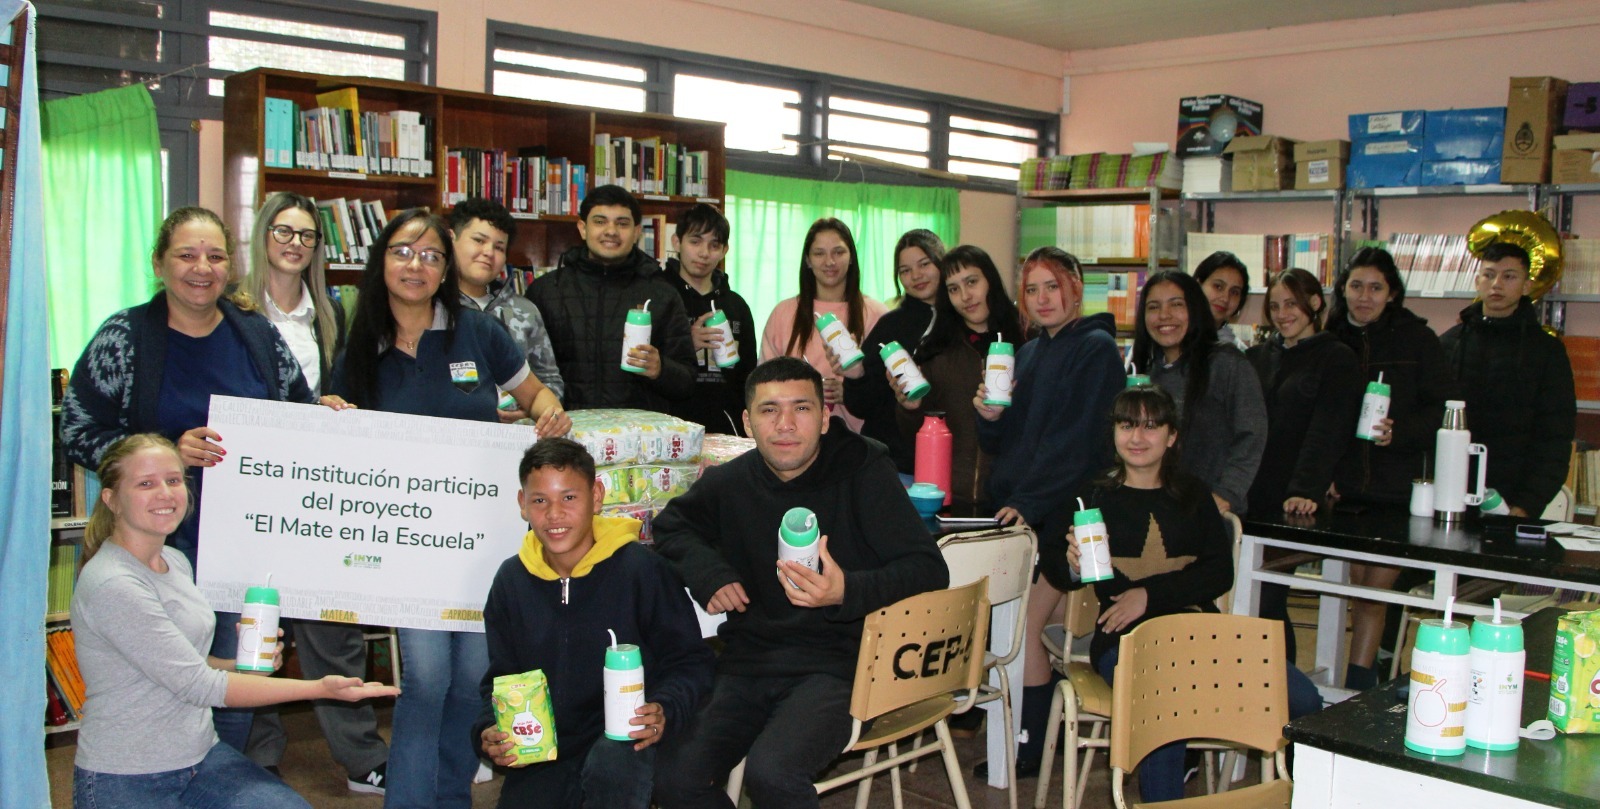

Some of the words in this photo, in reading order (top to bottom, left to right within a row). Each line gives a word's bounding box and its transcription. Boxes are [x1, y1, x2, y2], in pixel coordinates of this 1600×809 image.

[239, 456, 284, 478] Esta
[291, 461, 400, 489] institución
[407, 475, 499, 499] participa
[302, 491, 333, 511] del
[340, 499, 432, 519] proyecto
[245, 513, 272, 533] “El
[280, 516, 333, 538] Mate
[339, 525, 364, 541] en
[372, 525, 389, 543] la
[396, 527, 485, 550] Escuela”
[353, 554, 382, 563] INYM
[320, 608, 354, 621] MATEAR
[366, 770, 383, 787] N
